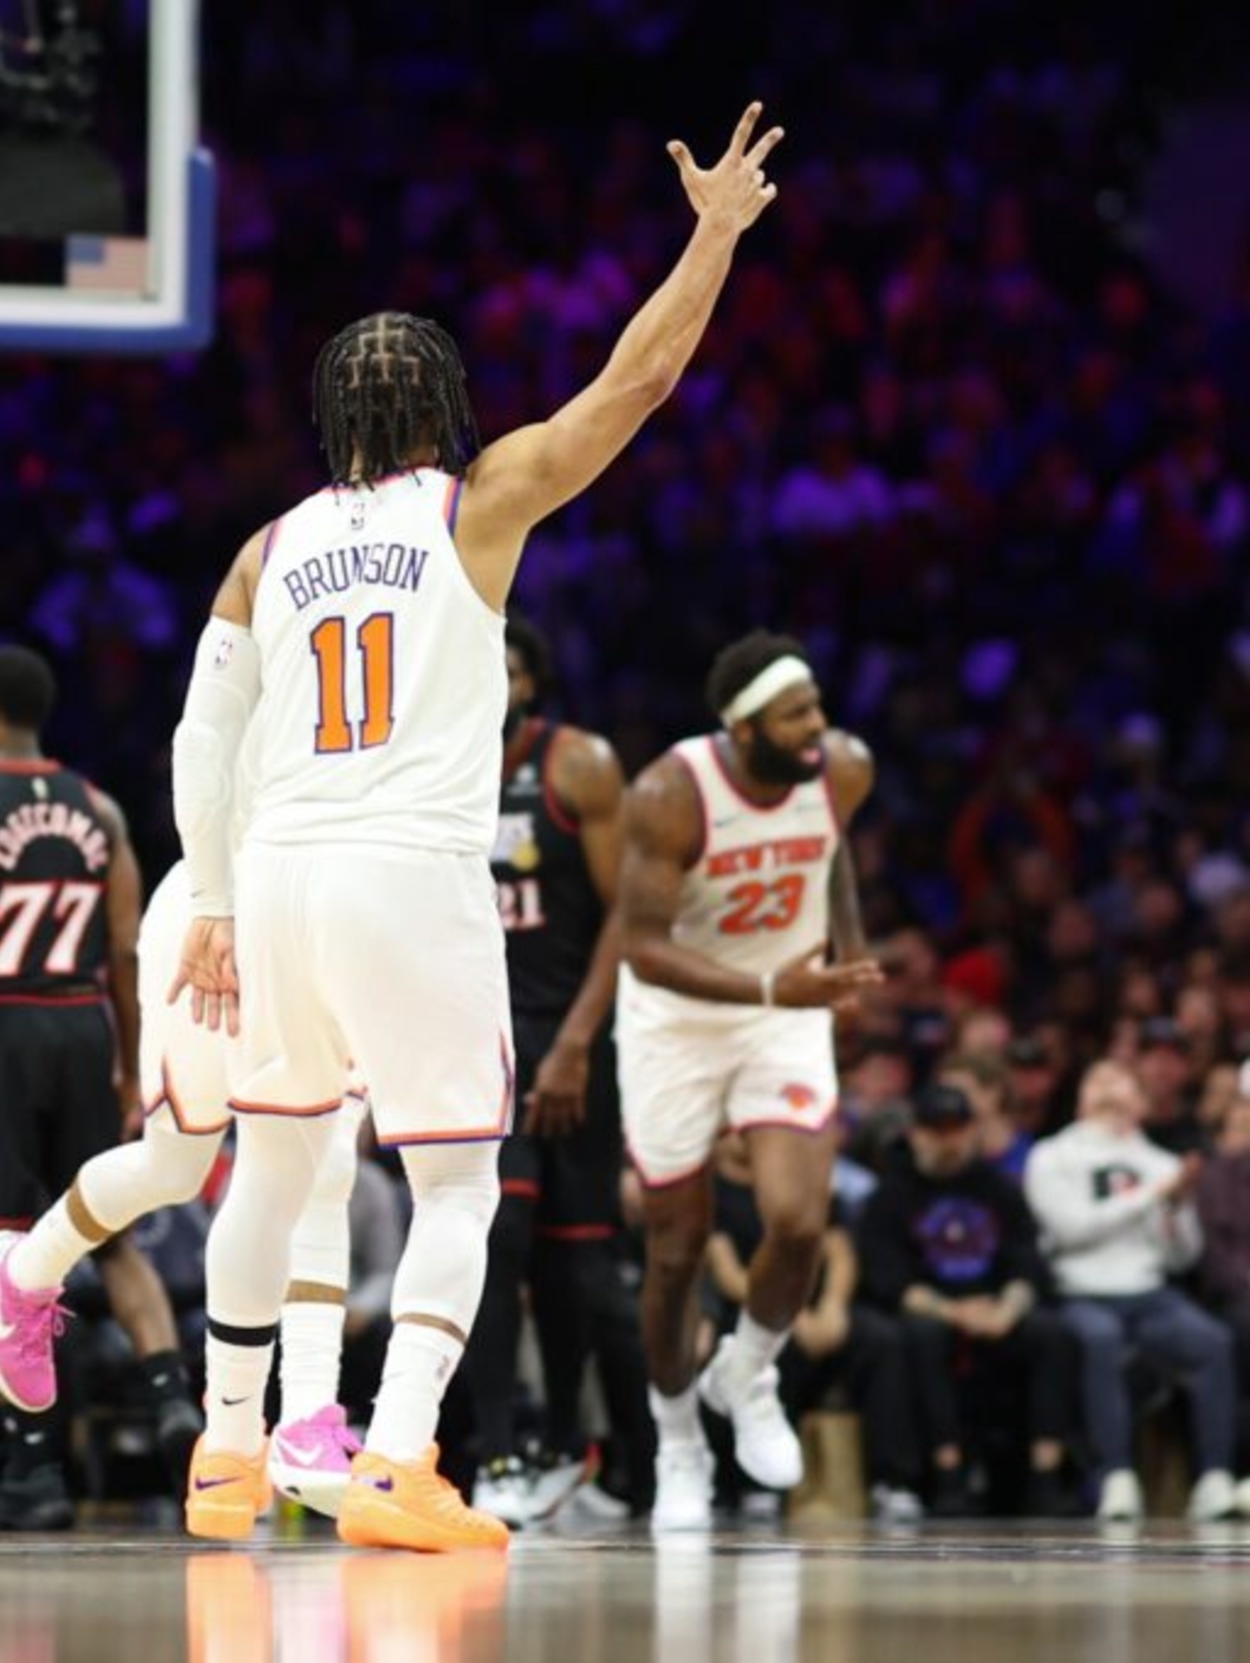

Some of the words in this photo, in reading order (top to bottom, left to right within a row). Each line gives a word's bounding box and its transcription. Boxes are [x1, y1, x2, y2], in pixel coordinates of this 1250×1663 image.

[283, 542, 429, 611] BRUNSON
[310, 612, 395, 755] 11
[706, 844, 767, 877] NEW
[769, 836, 828, 865] YORK
[718, 873, 806, 936] 23
